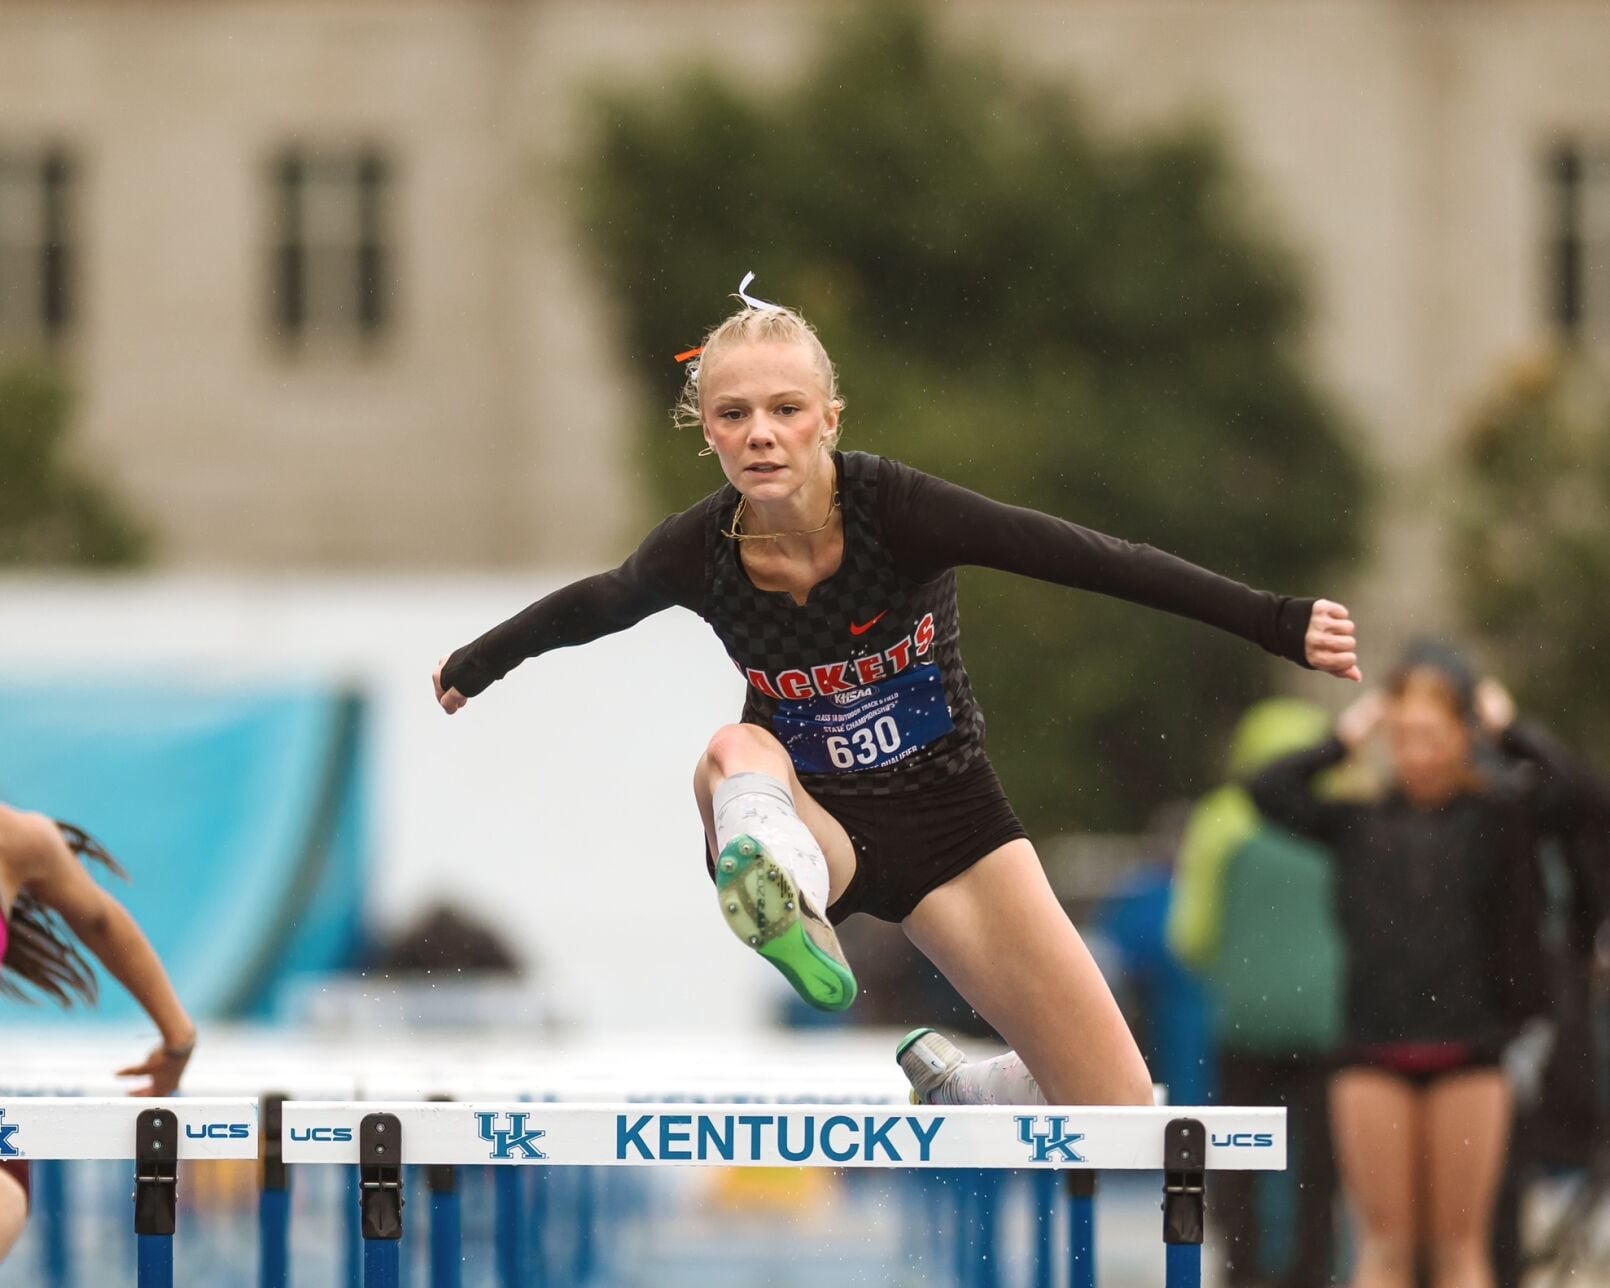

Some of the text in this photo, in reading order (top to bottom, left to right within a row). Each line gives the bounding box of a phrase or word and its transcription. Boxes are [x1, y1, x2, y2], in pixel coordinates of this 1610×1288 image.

[733, 613, 935, 700] ACKETS
[834, 687, 873, 705] KHSAA
[815, 714, 831, 722] CLASS
[838, 708, 861, 722] OUTDOOR
[861, 701, 879, 711] TRACK
[884, 692, 899, 702] FIELD
[823, 724, 845, 732] STATE
[826, 715, 901, 769] 630
[186, 1124, 250, 1139] UCS
[290, 1128, 353, 1142] UCS
[616, 1115, 945, 1161] KENTUCKY
[1211, 1133, 1274, 1147] UCS
